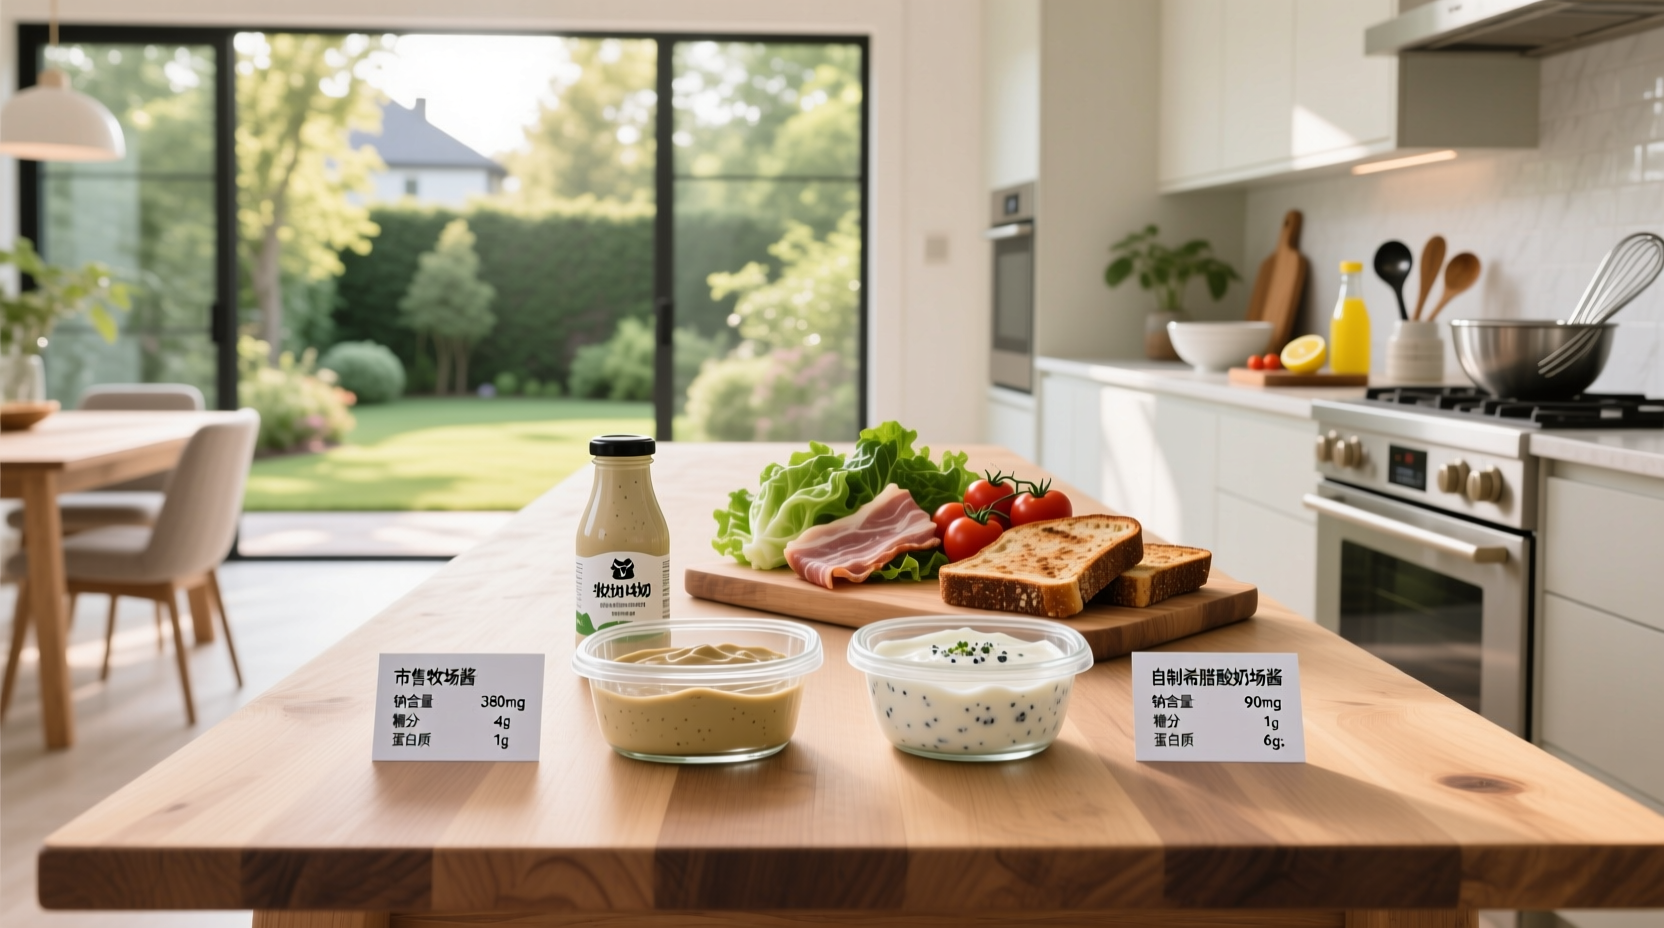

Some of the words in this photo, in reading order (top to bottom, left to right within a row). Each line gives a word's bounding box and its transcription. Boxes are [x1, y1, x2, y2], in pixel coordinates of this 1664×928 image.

[394, 667, 477, 686] 市售牧场酱
[481, 695, 526, 711] 380mg
[1244, 695, 1282, 711] 90mg
[493, 715, 511, 729] 4g
[1263, 715, 1279, 731] 1g
[493, 733, 509, 750] 1g
